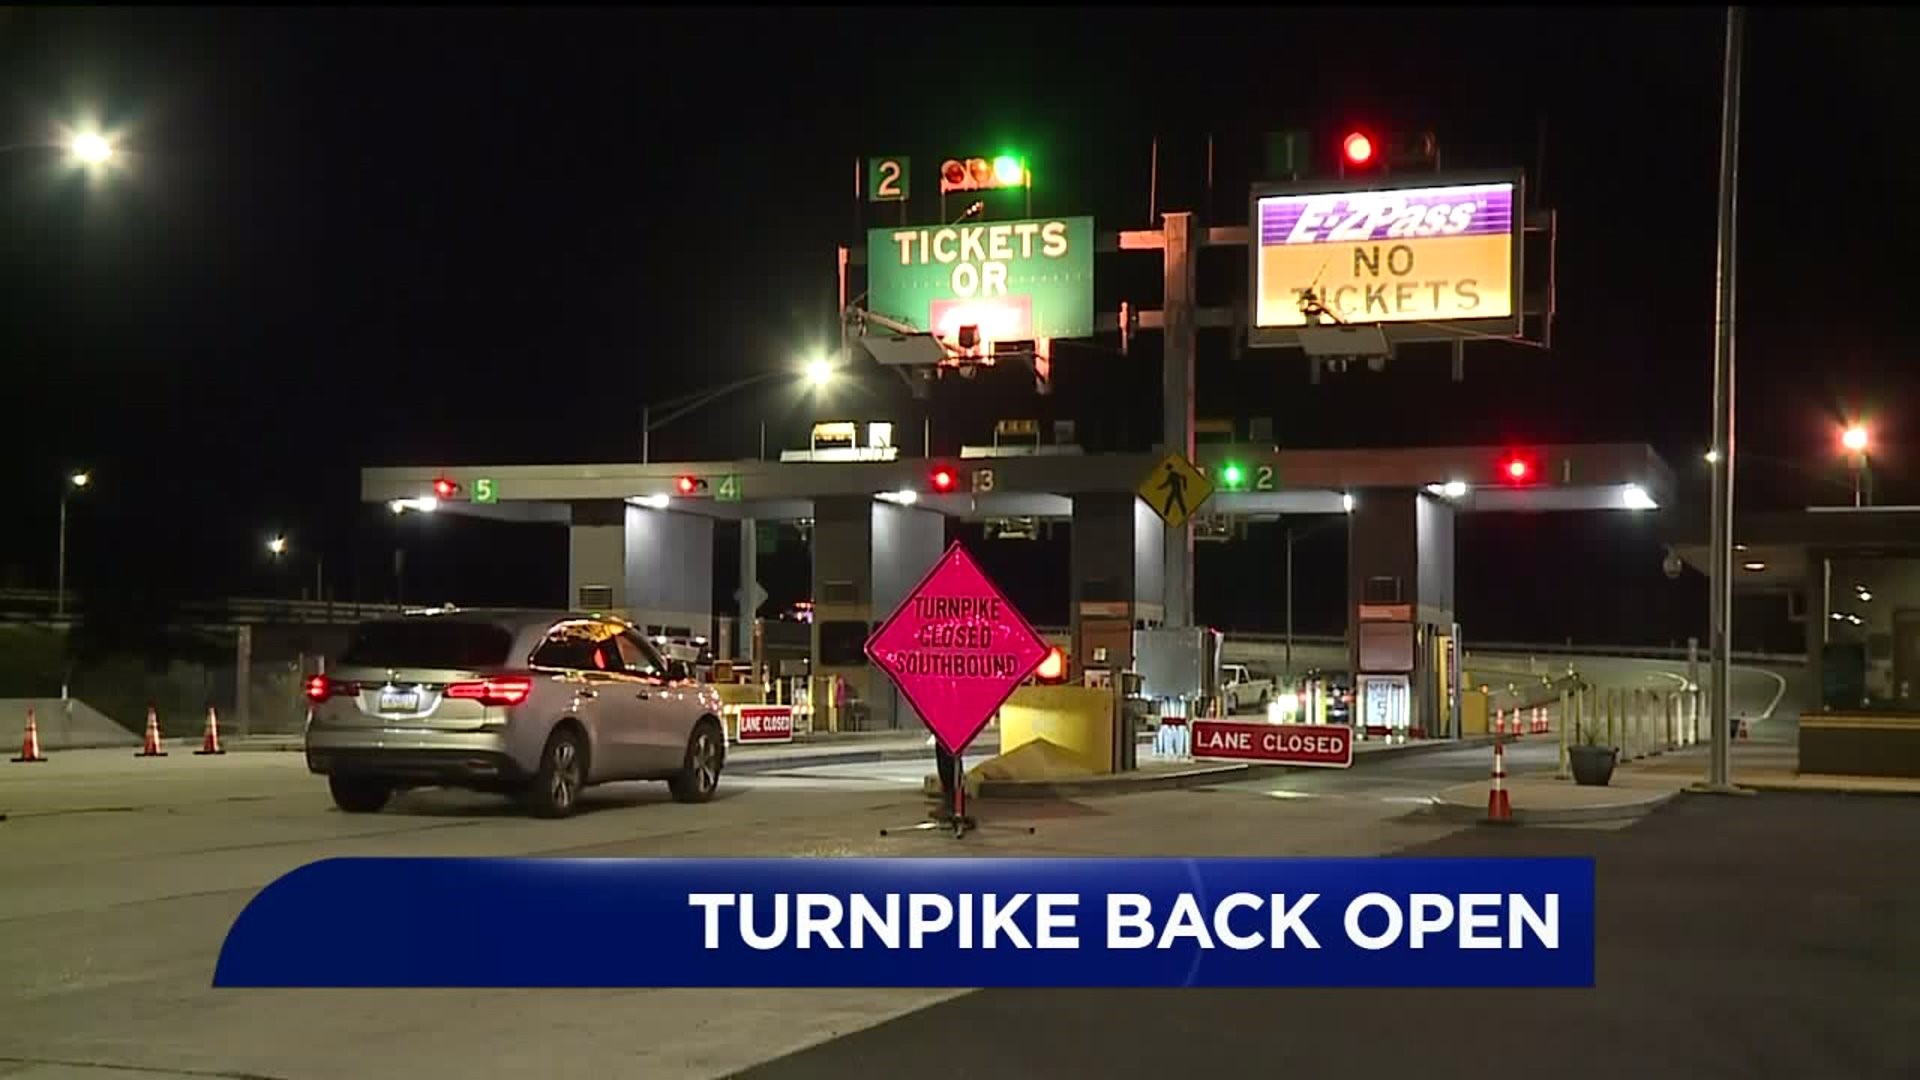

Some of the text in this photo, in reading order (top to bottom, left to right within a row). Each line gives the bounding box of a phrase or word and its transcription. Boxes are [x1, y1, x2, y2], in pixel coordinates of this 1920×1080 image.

[878, 160, 901, 196] 2
[894, 221, 1068, 265] TICKETS
[1353, 244, 1414, 278] NO
[951, 261, 1008, 298] OR
[477, 479, 491, 500] 5
[719, 475, 734, 498] 4
[980, 469, 994, 491] 3
[1257, 466, 1273, 490] 2
[912, 597, 1000, 621] TURNPIKE
[919, 624, 992, 649] CLOSED
[895, 653, 1018, 677] SOUTHBOUND
[741, 715, 790, 732] LANE CLOSED
[1196, 731, 1344, 755] LANE CLOSED
